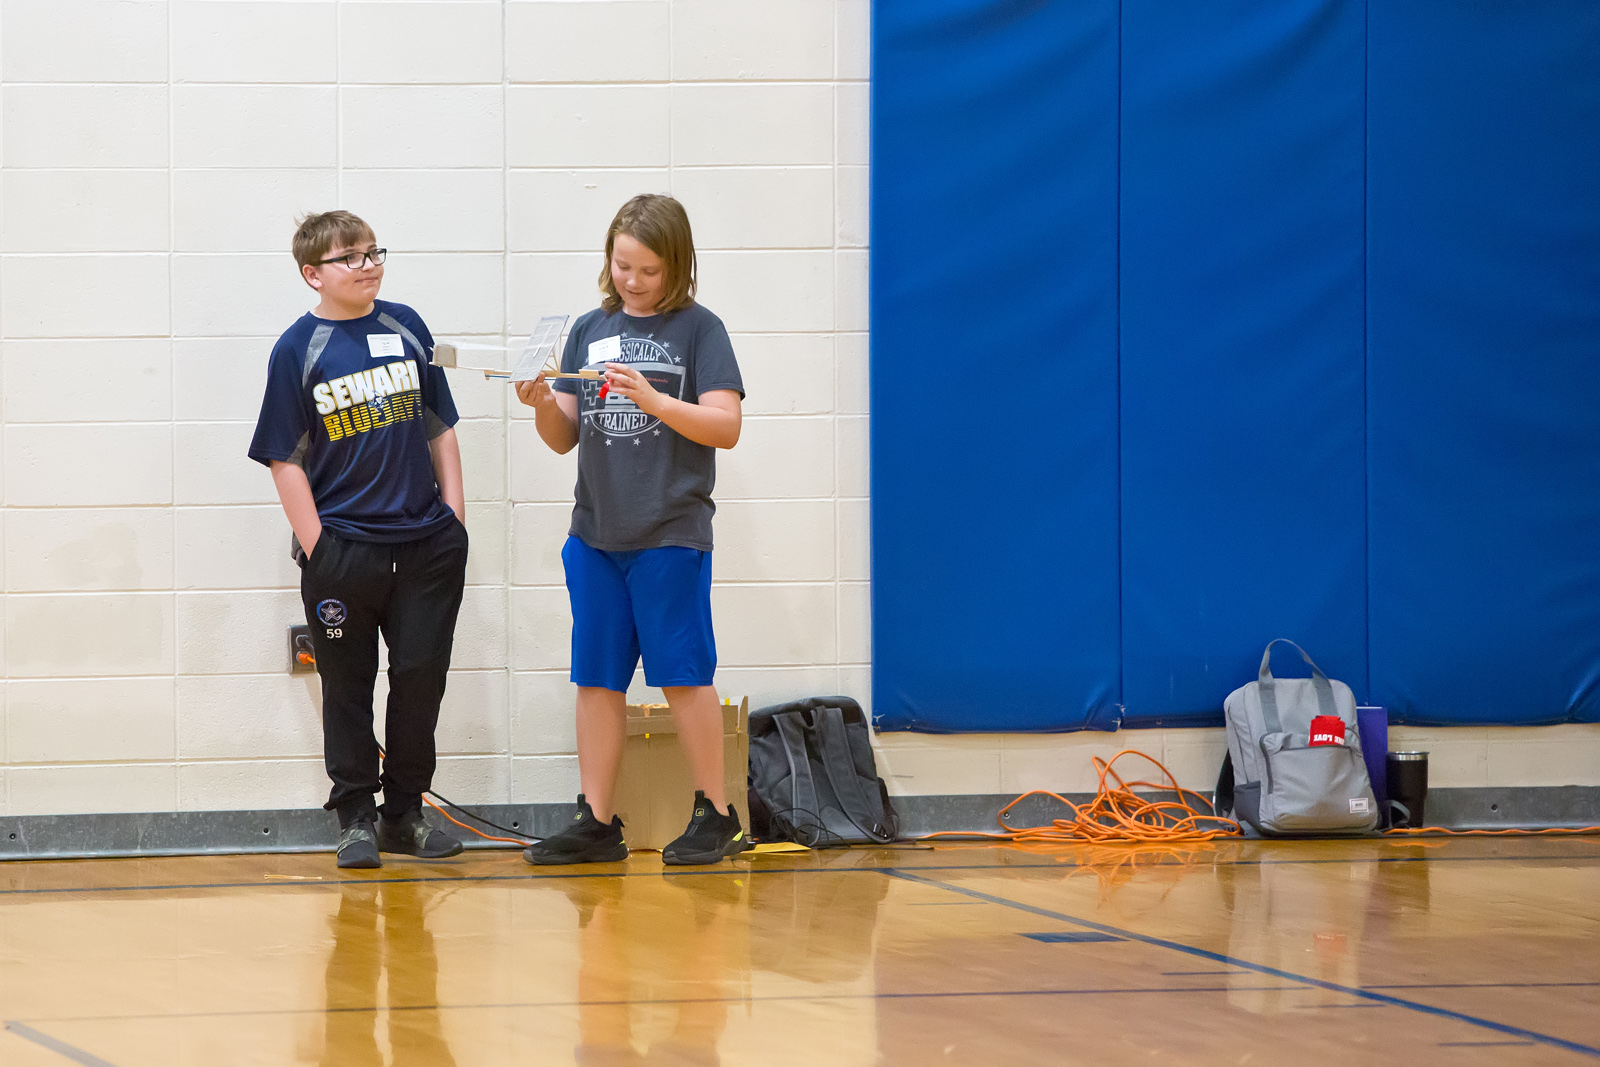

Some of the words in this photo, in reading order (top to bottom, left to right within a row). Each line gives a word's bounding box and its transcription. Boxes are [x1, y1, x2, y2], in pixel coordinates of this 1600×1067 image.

[603, 342, 661, 362] SSICALLY
[598, 413, 648, 431] TRAINED
[326, 628, 343, 639] 59
